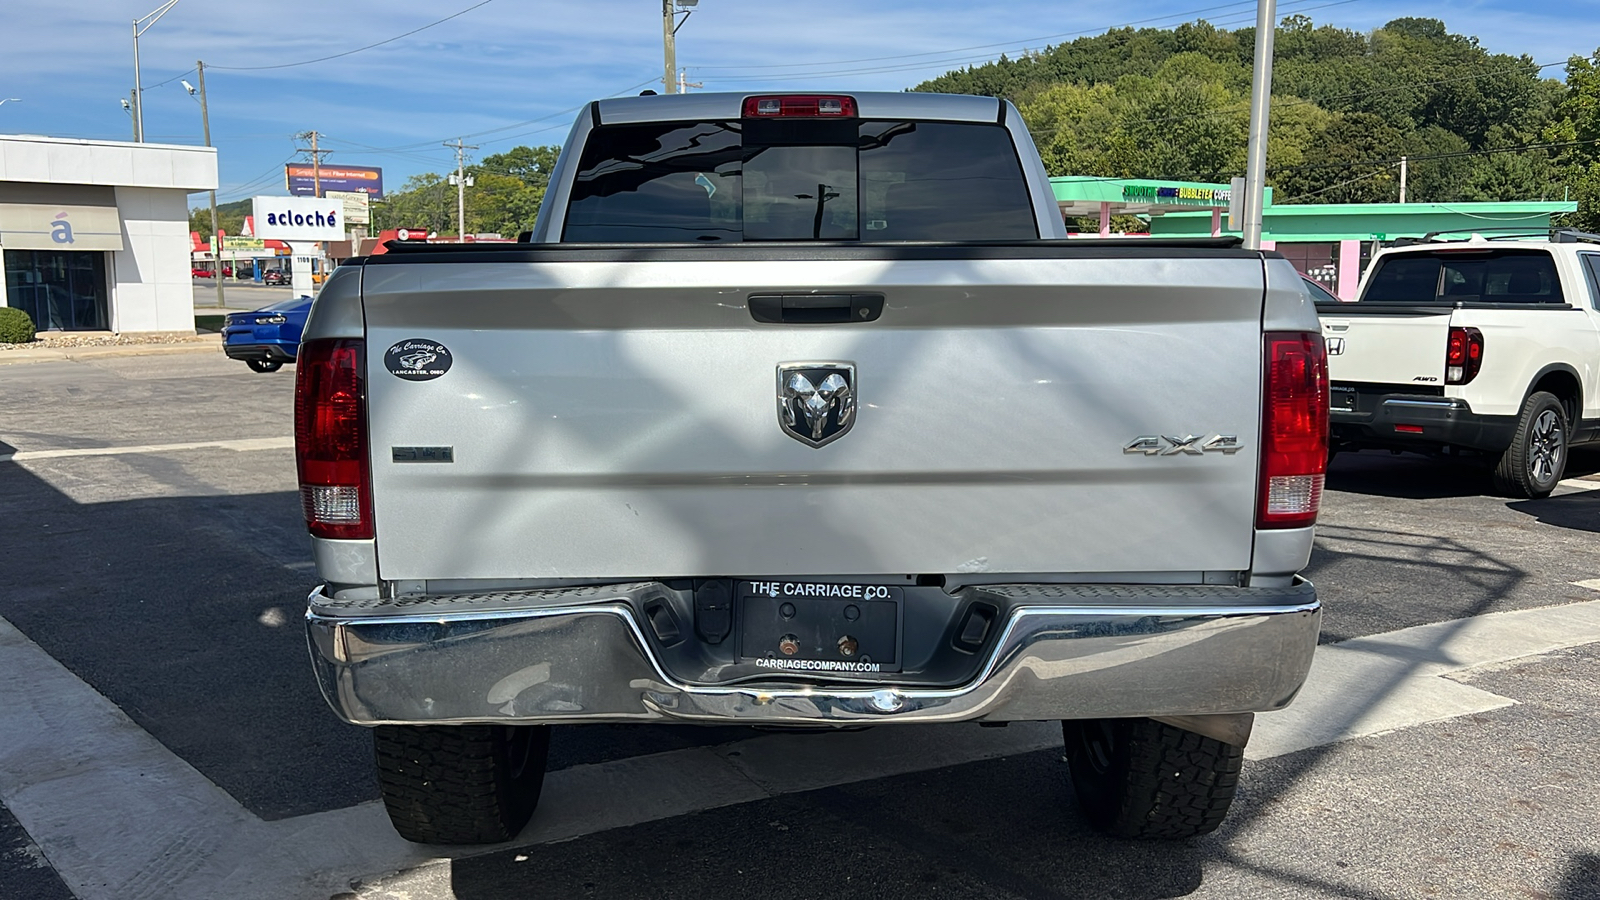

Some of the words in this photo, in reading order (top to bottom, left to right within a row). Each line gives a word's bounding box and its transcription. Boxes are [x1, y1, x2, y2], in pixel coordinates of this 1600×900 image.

[1214, 189, 1231, 201] COFFE
[267, 209, 336, 227] acloché
[390, 345, 402, 355] The
[403, 342, 434, 352] Carriage
[1123, 434, 1244, 456] 4X4
[750, 582, 780, 595] THE
[783, 583, 862, 597] CARRIAGE
[864, 585, 891, 599] CO.
[756, 658, 880, 672] CARRIAGECOMPANY.COM
